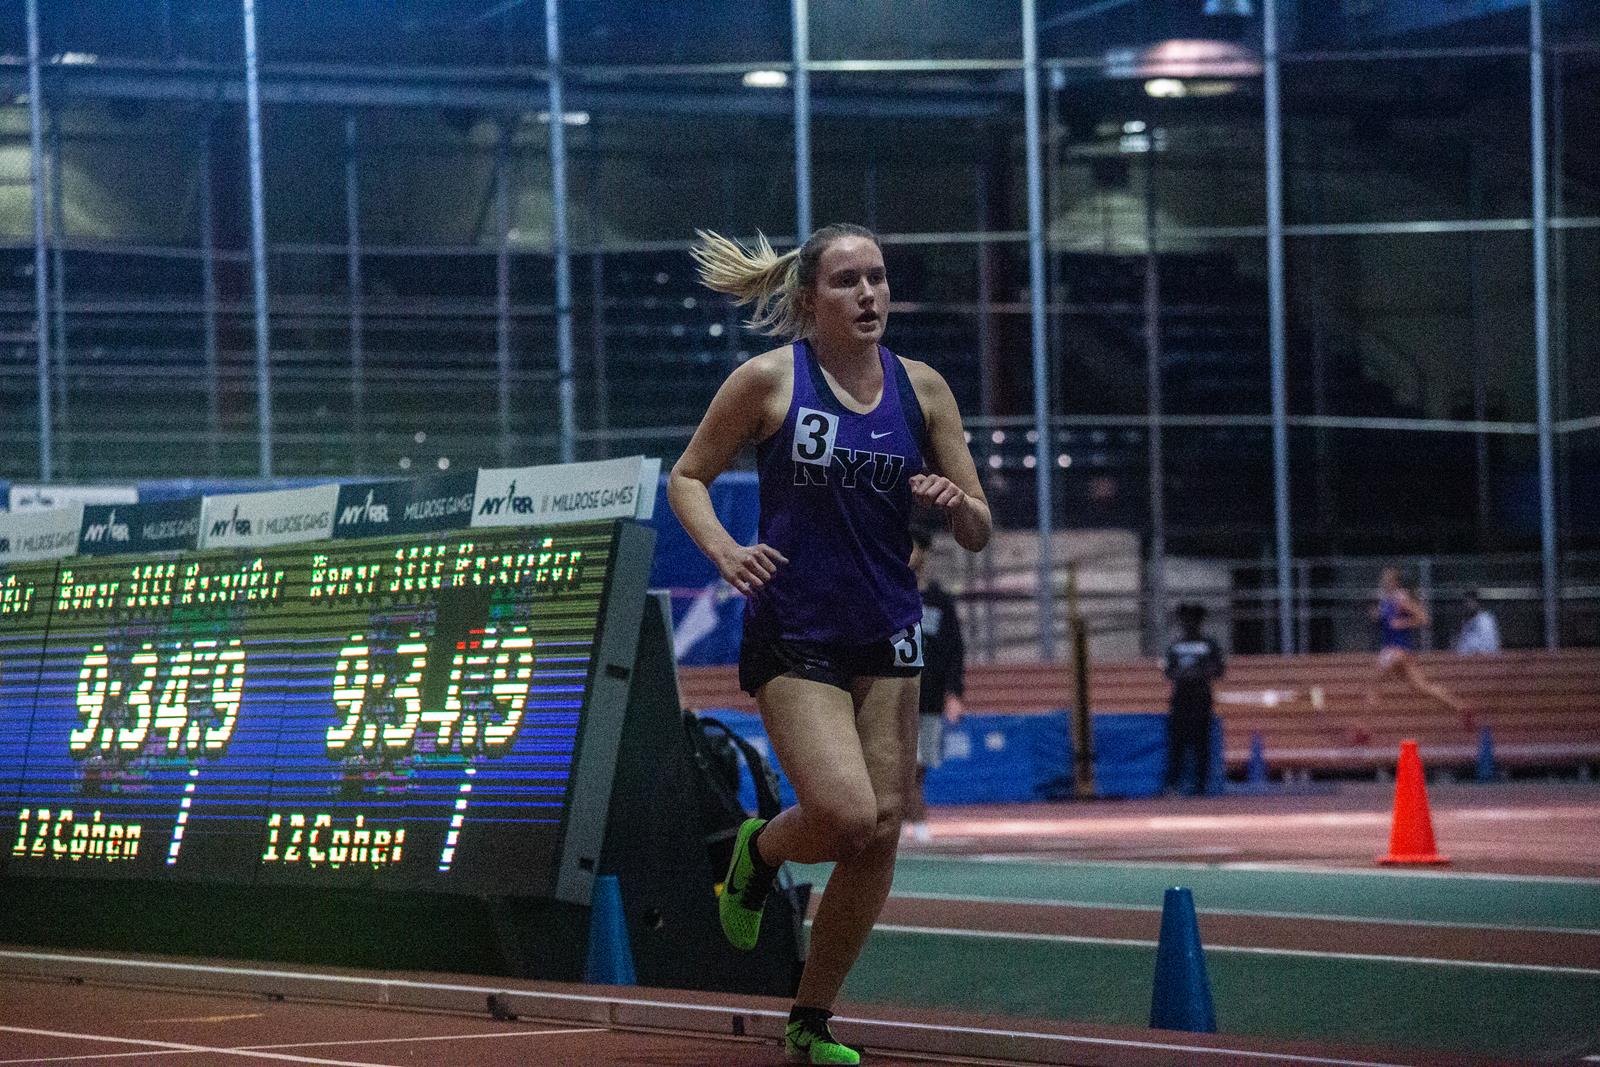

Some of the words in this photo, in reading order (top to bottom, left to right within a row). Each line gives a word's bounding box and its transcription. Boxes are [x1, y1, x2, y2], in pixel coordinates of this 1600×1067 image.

[796, 413, 830, 461] 3
[793, 447, 905, 493] NYU
[404, 497, 446, 520] MILLROSE
[552, 491, 601, 512] MILLROSE
[602, 485, 634, 506] GAMES
[899, 623, 919, 665] 3
